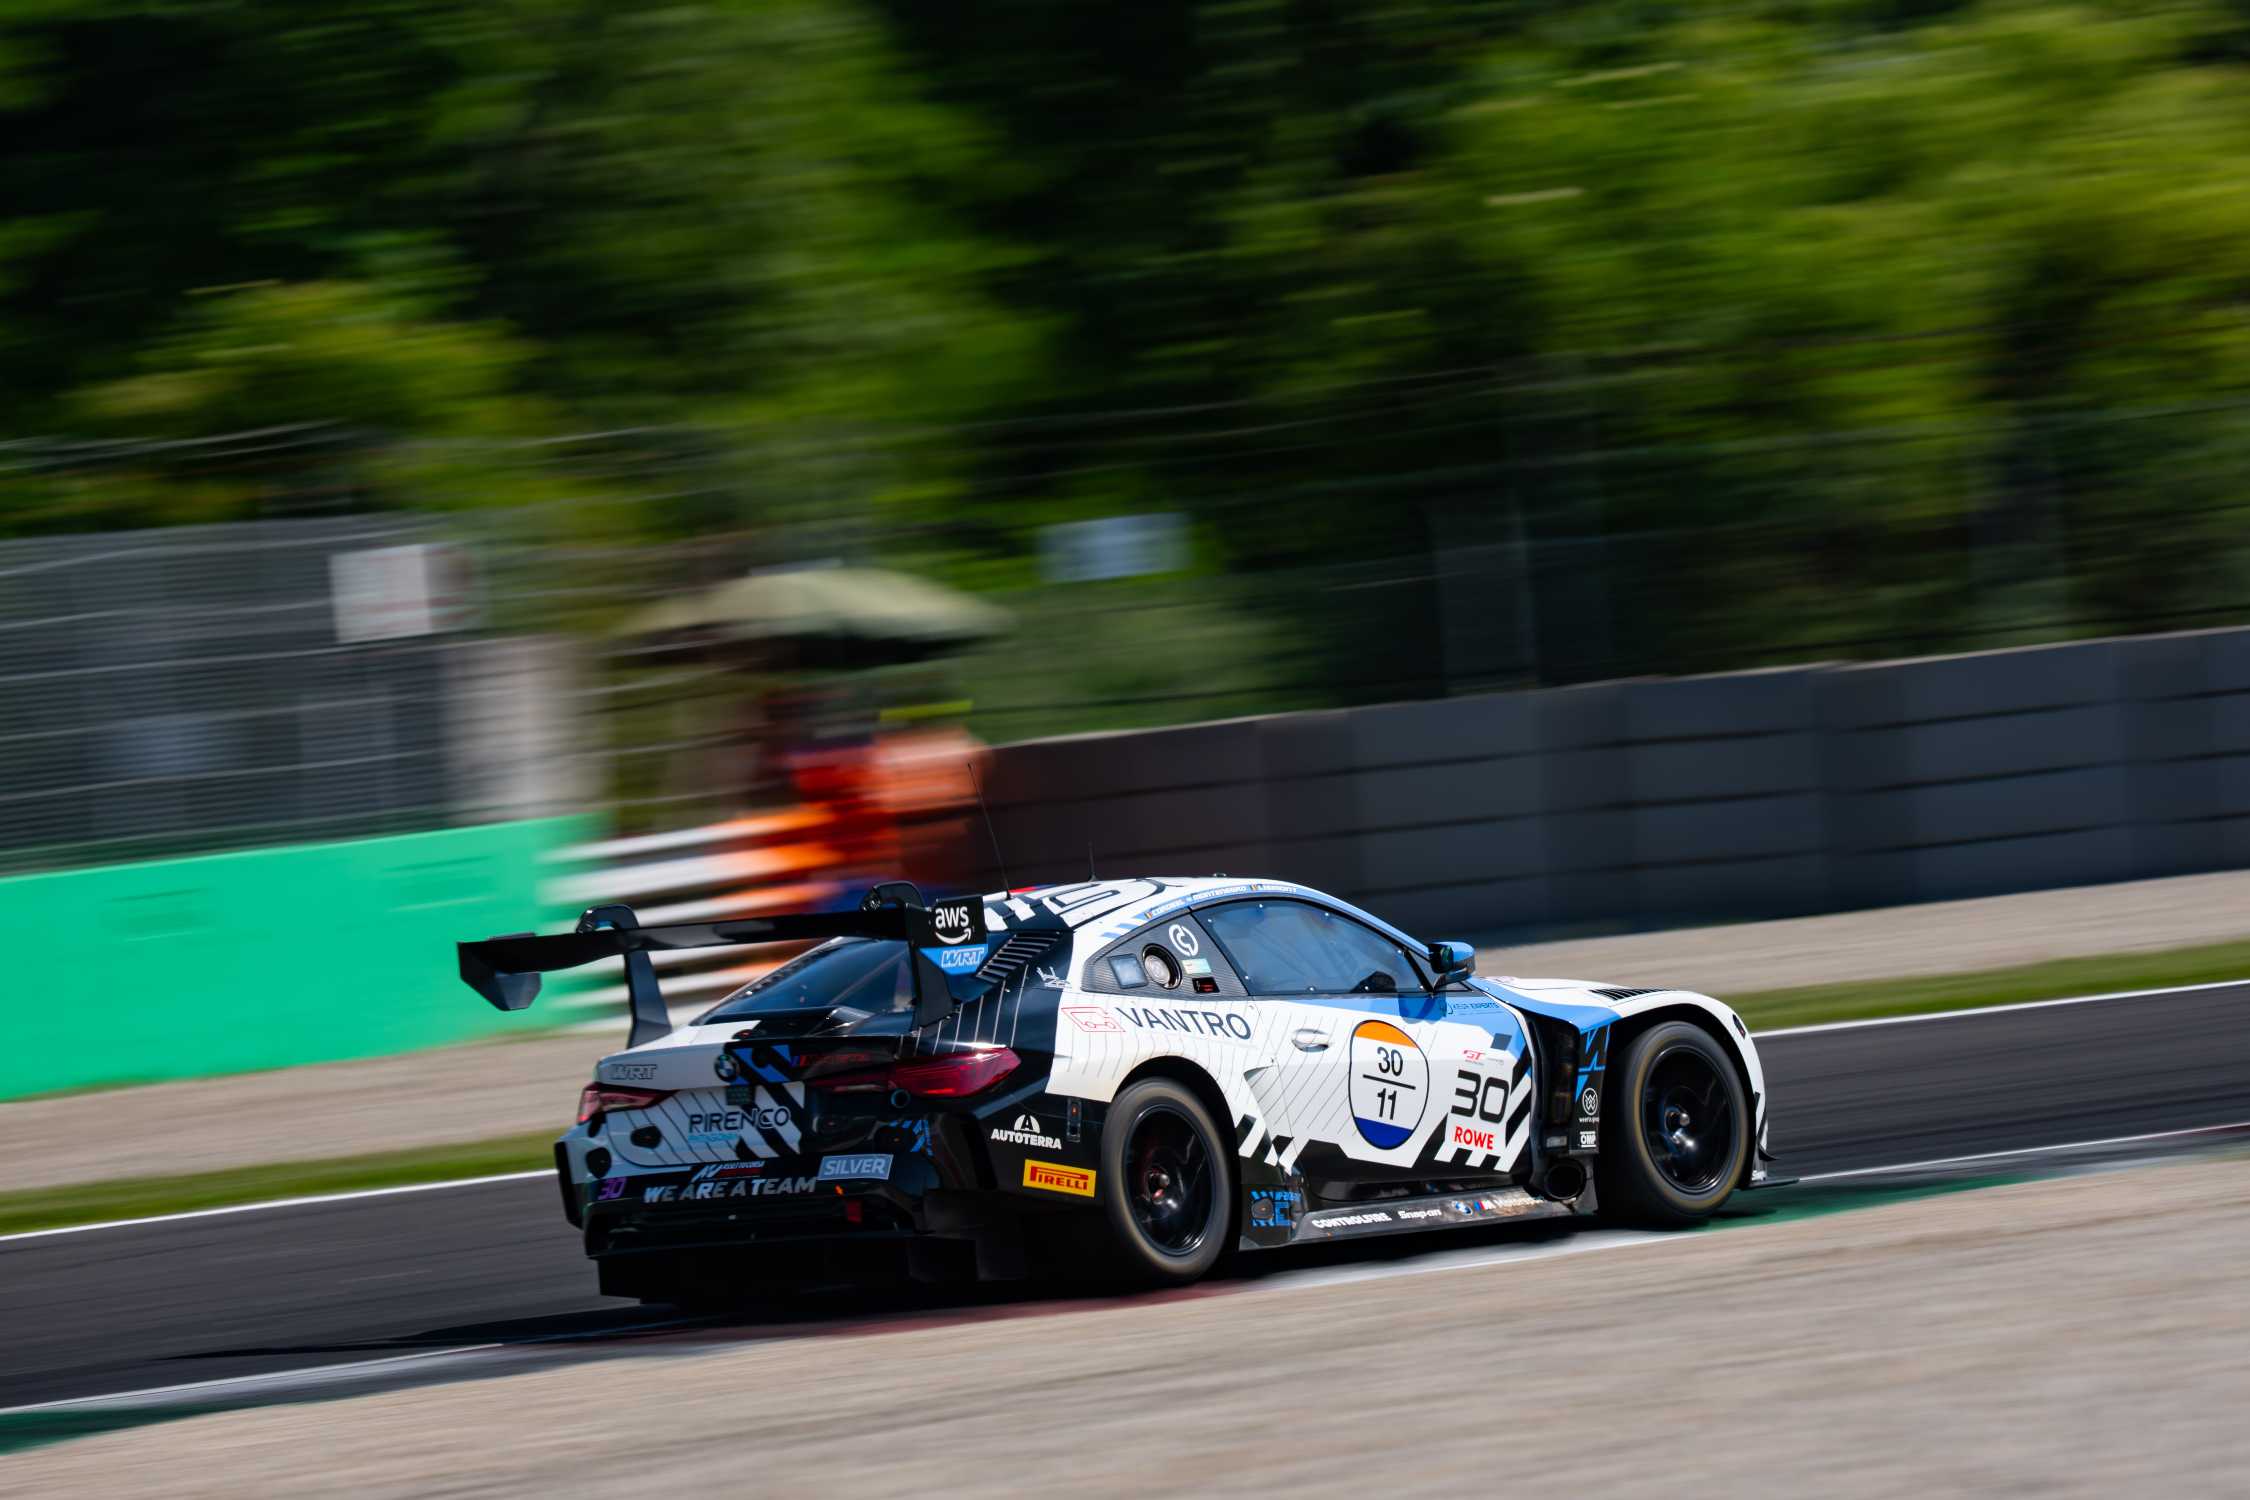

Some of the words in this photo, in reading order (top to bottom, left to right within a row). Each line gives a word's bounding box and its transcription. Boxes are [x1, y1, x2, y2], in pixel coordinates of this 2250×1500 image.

[935, 906, 969, 928] aws
[1117, 1007, 1251, 1041] VANTRO
[1376, 1046, 1403, 1077] 30
[1376, 1087, 1397, 1121] 11
[1450, 1068, 1510, 1124] 30
[689, 1106, 791, 1133] PIRENCO
[990, 1128, 1063, 1150] AUTOTERRA
[1454, 1125, 1495, 1151] ROWE
[1580, 1133, 1596, 1145] OMP
[823, 1157, 886, 1177] SILVER
[1029, 1166, 1089, 1190] PIRELLI
[643, 1183, 675, 1204] WE
[678, 1179, 728, 1201] ARE
[730, 1180, 748, 1198] A
[750, 1176, 817, 1195] TEAM
